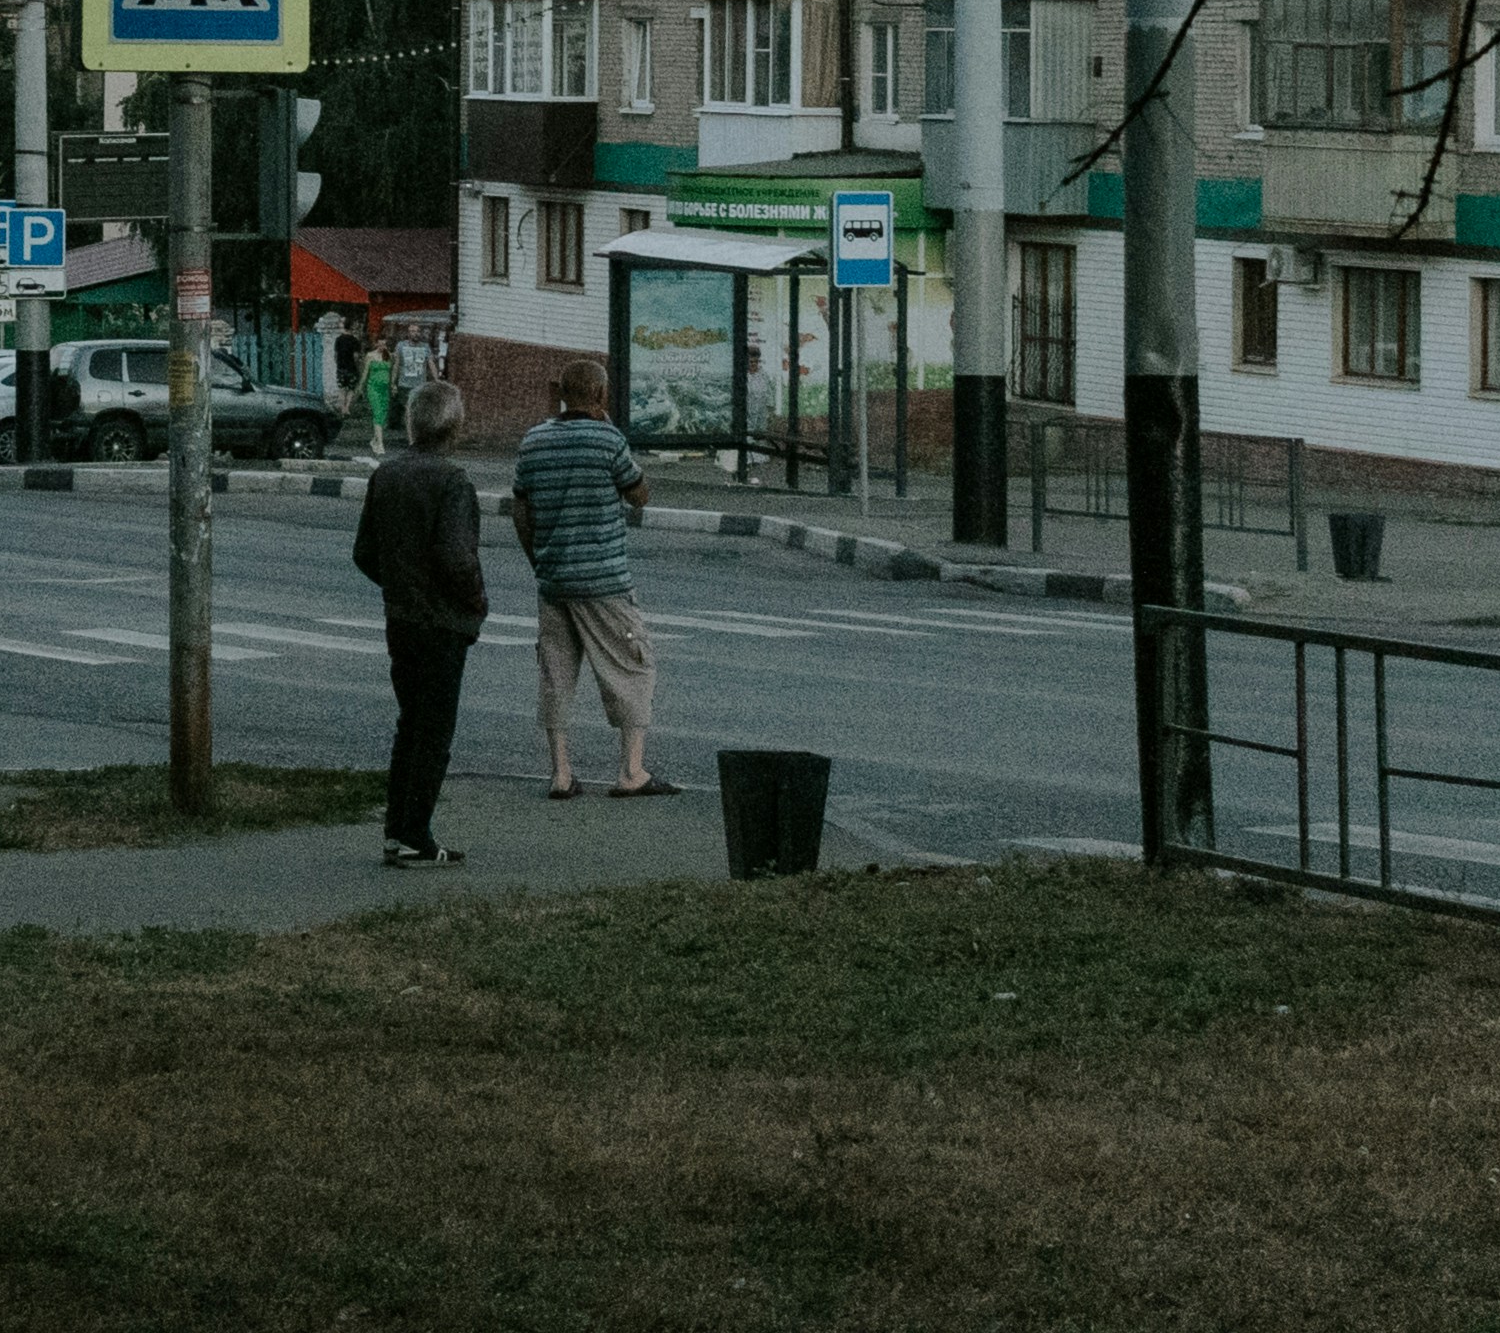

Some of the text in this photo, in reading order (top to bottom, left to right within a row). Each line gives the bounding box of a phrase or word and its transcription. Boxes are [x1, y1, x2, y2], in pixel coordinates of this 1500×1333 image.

[684, 202, 718, 217] БОРЬБЕ
[719, 204, 728, 218] С
[728, 203, 811, 220] БОЛЕЗНЯМИ
[23, 216, 55, 261] P
